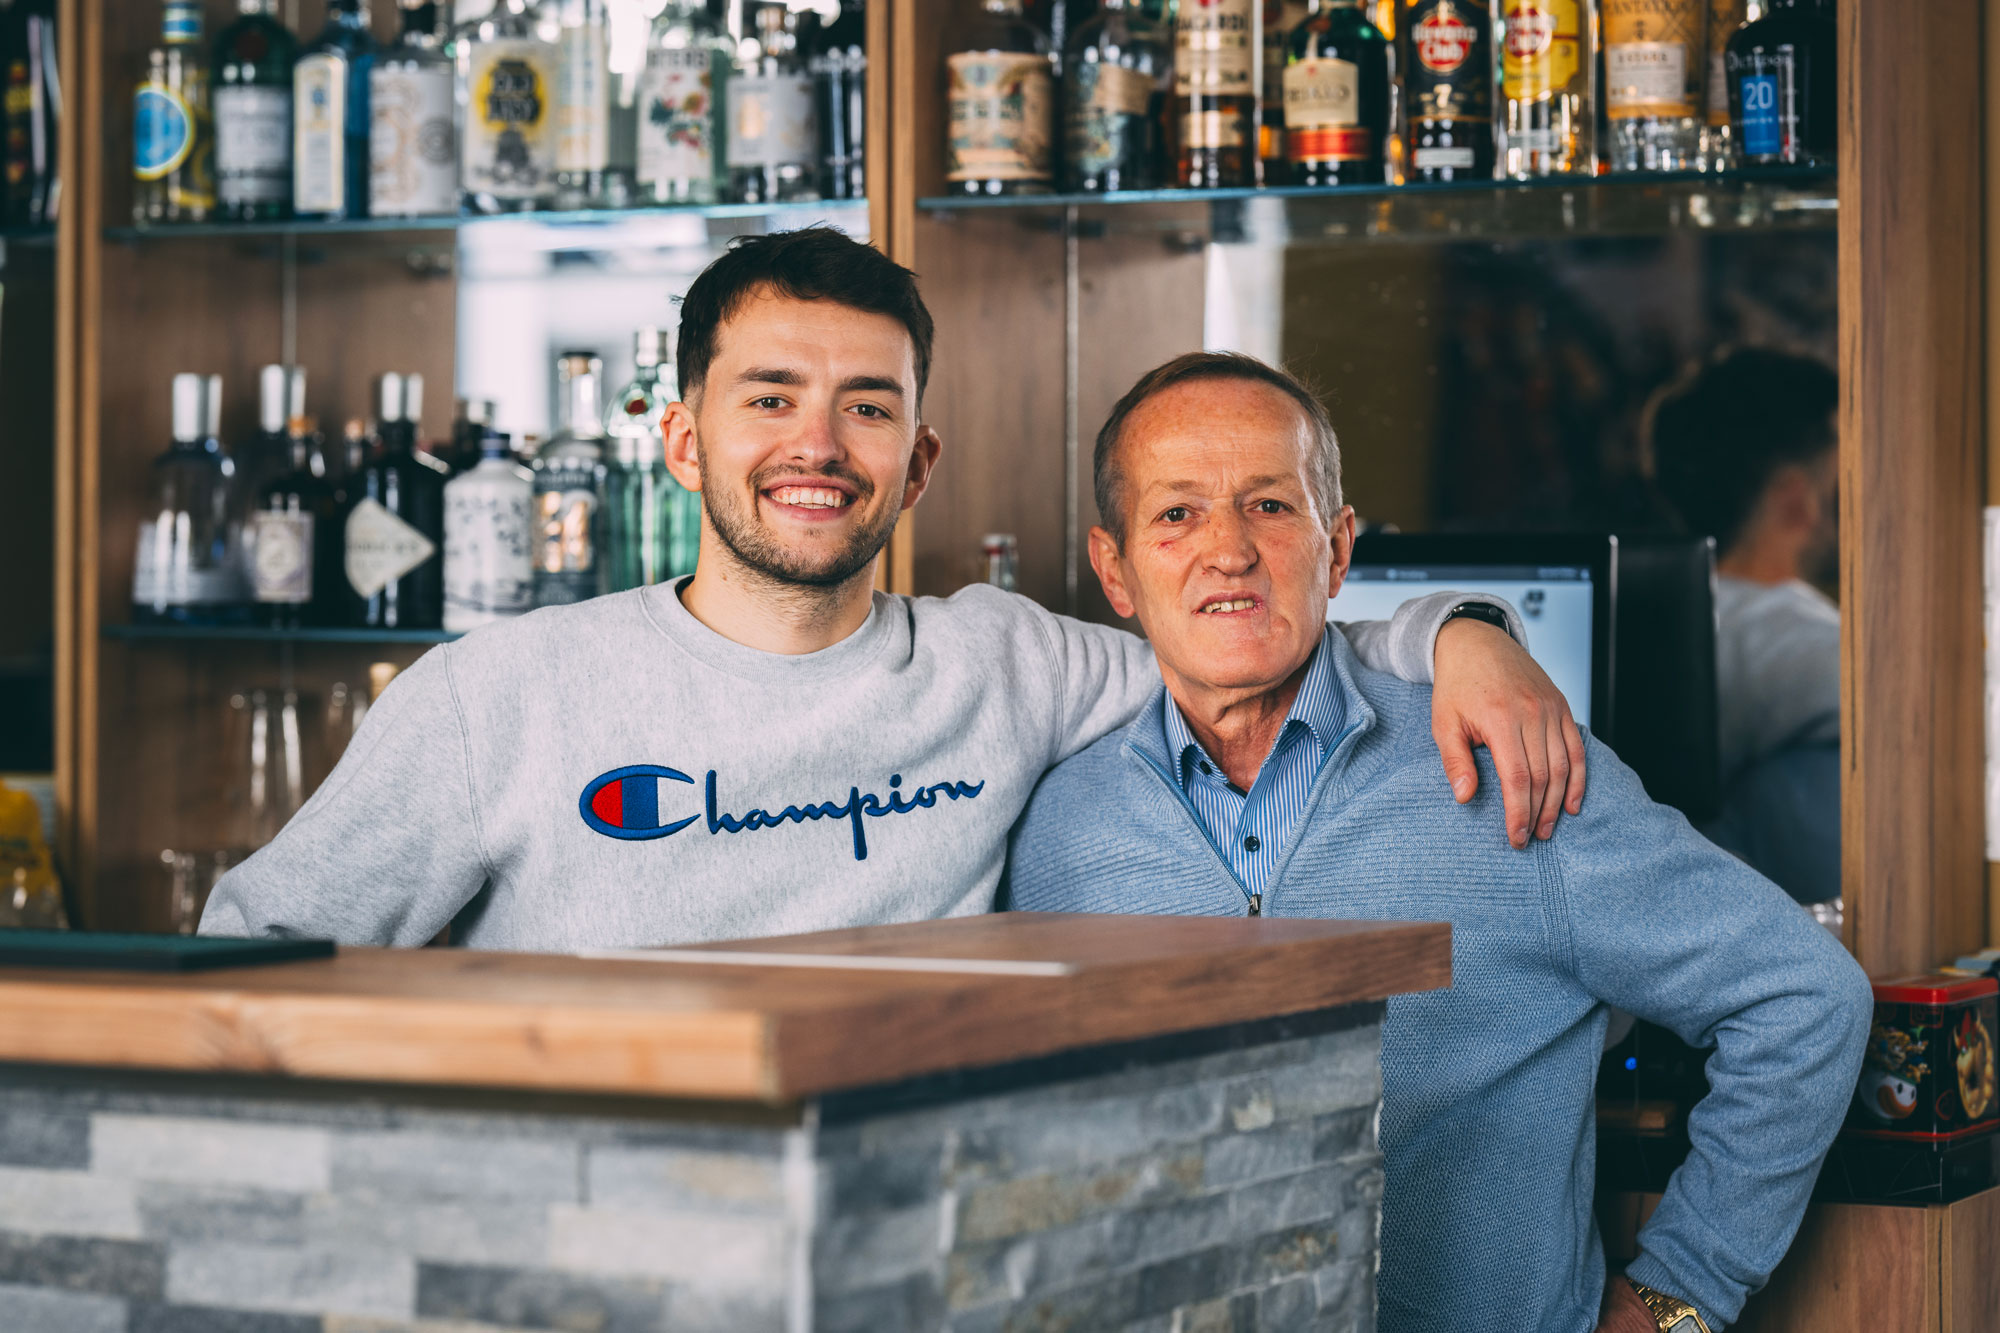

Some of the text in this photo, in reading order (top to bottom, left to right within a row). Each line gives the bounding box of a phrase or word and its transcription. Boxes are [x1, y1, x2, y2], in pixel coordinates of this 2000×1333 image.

[1433, 83, 1452, 108] 7
[1744, 81, 1773, 111] 20
[579, 764, 985, 861] Champion
